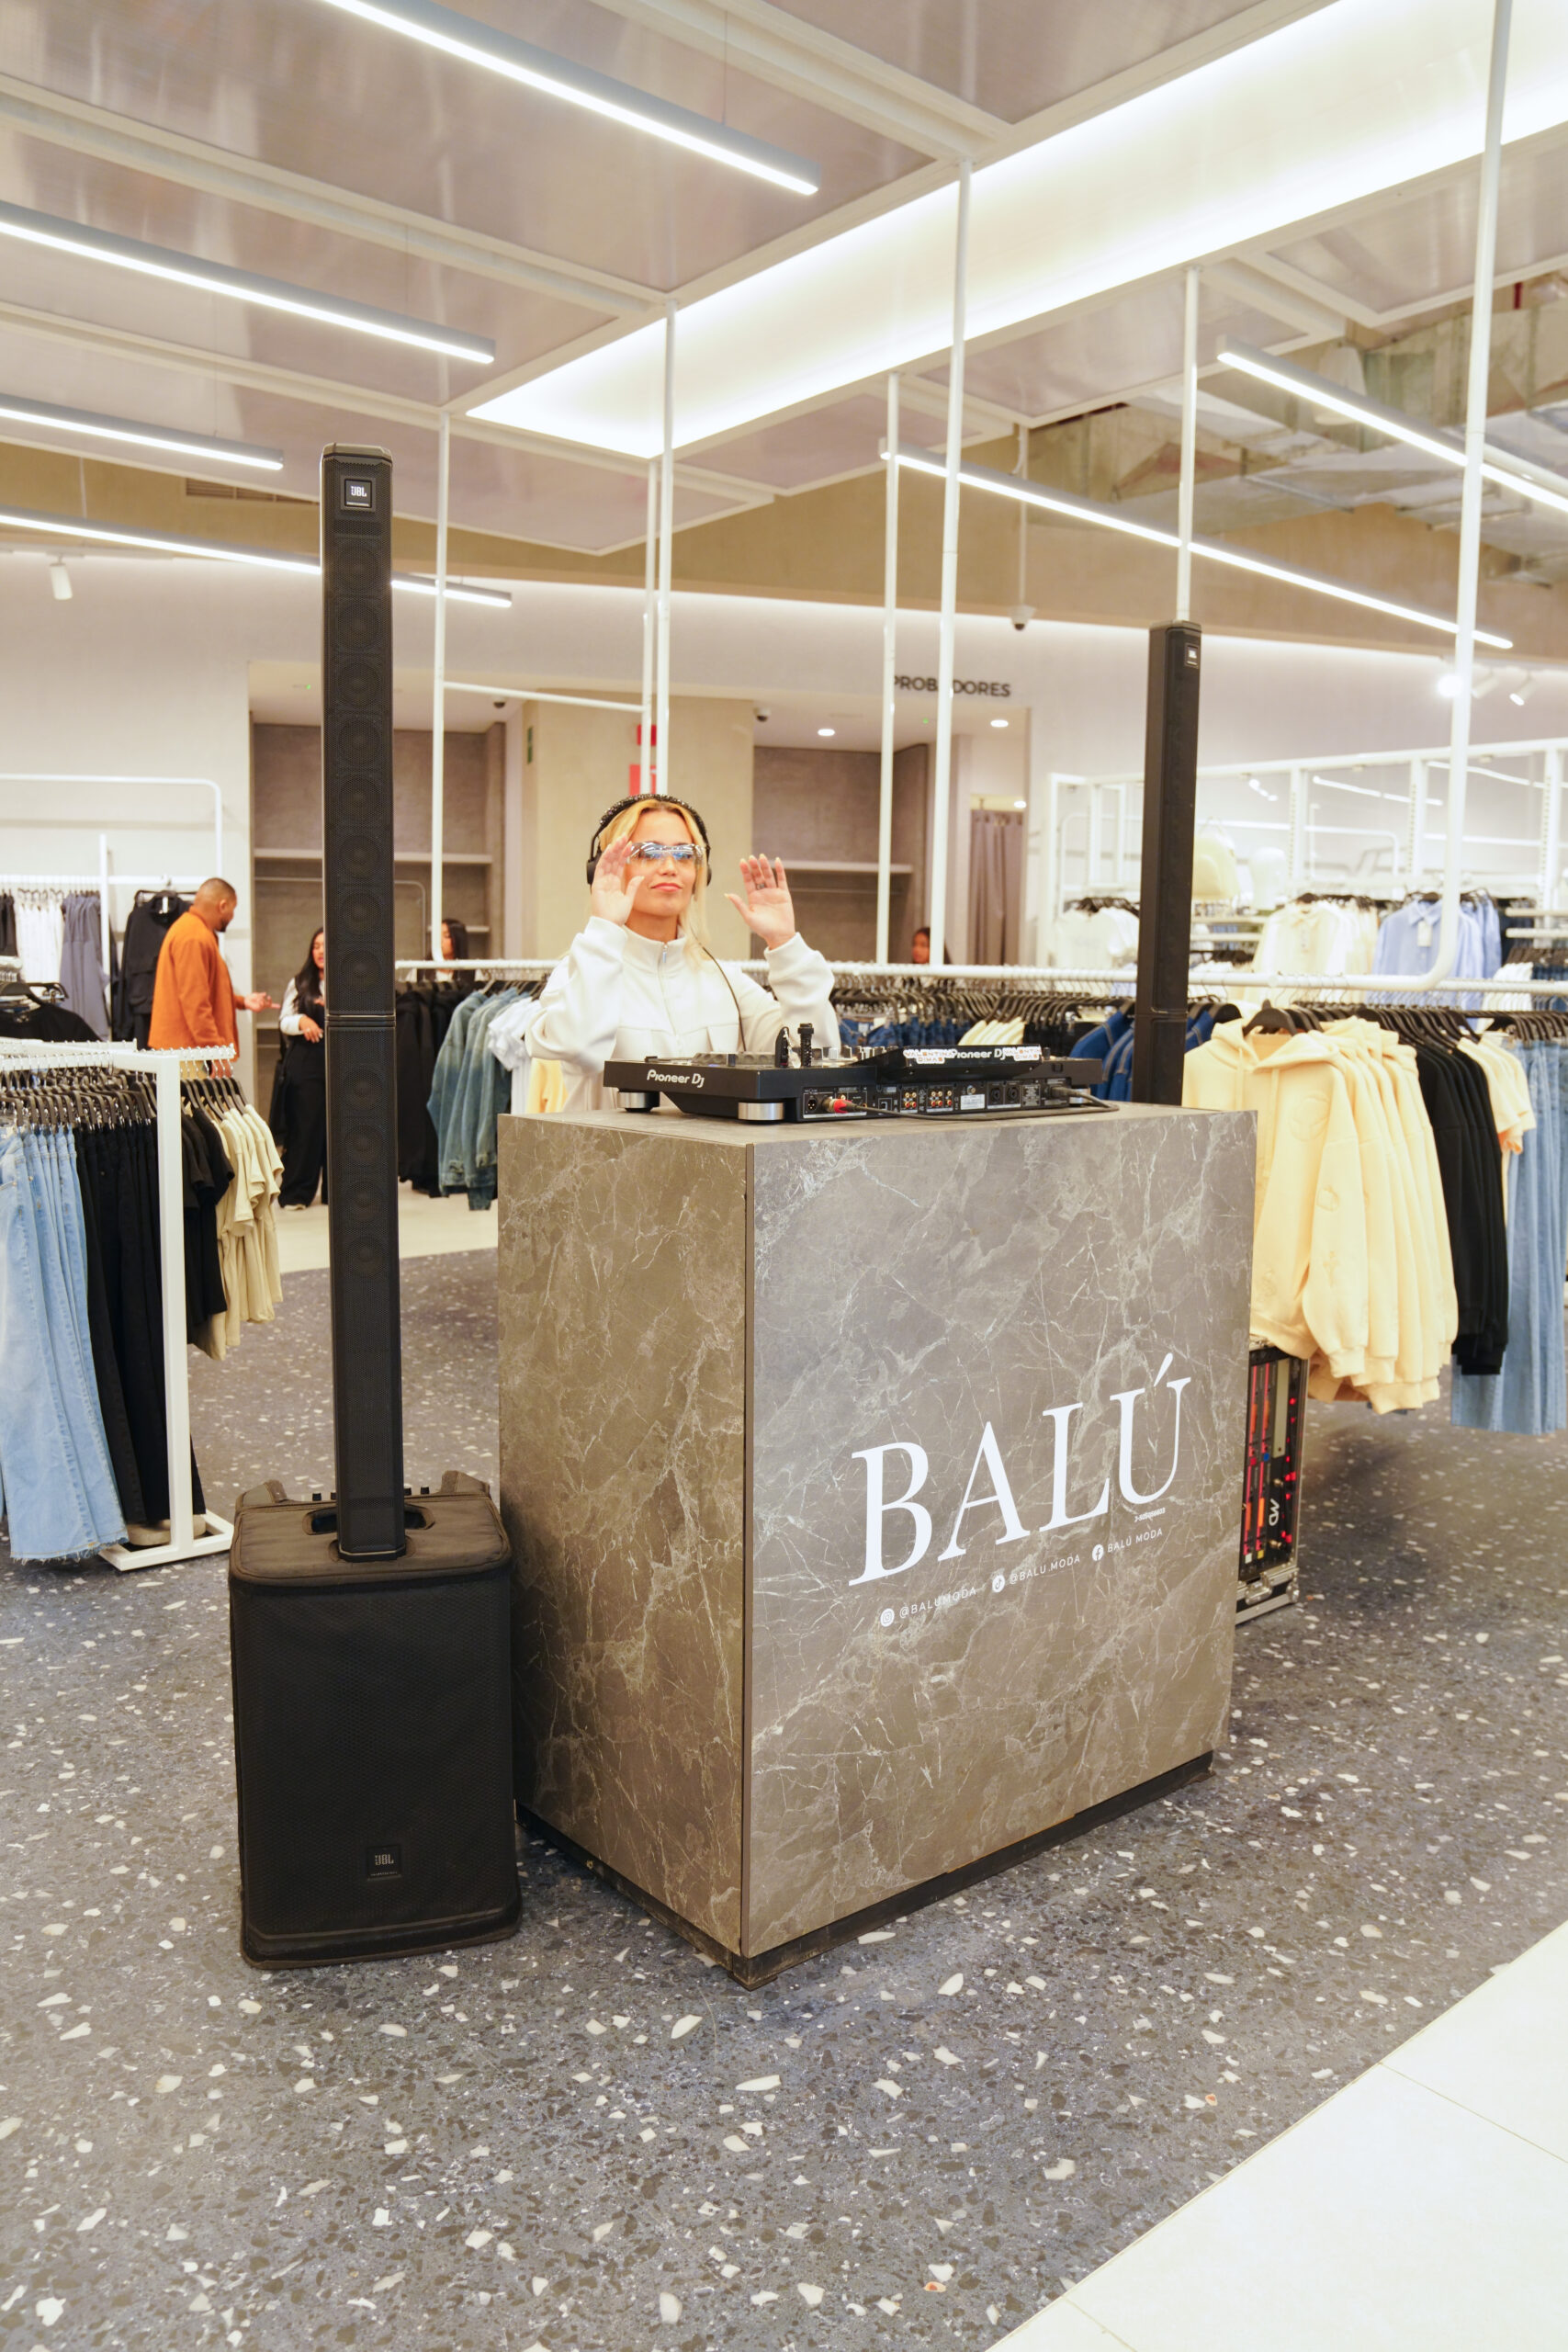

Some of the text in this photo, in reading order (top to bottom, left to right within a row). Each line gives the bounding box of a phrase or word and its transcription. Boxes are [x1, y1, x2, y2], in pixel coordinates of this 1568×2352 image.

[350, 485, 367, 497] JBL
[894, 675, 1011, 697] ROBDORES
[952, 1048, 992, 1059] Pioneer
[646, 1069, 690, 1084] Pioneer
[848, 1352, 1191, 1587] BALÚ
[1135, 1527, 1163, 1544] MODA
[374, 1853, 395, 1866] JBL
